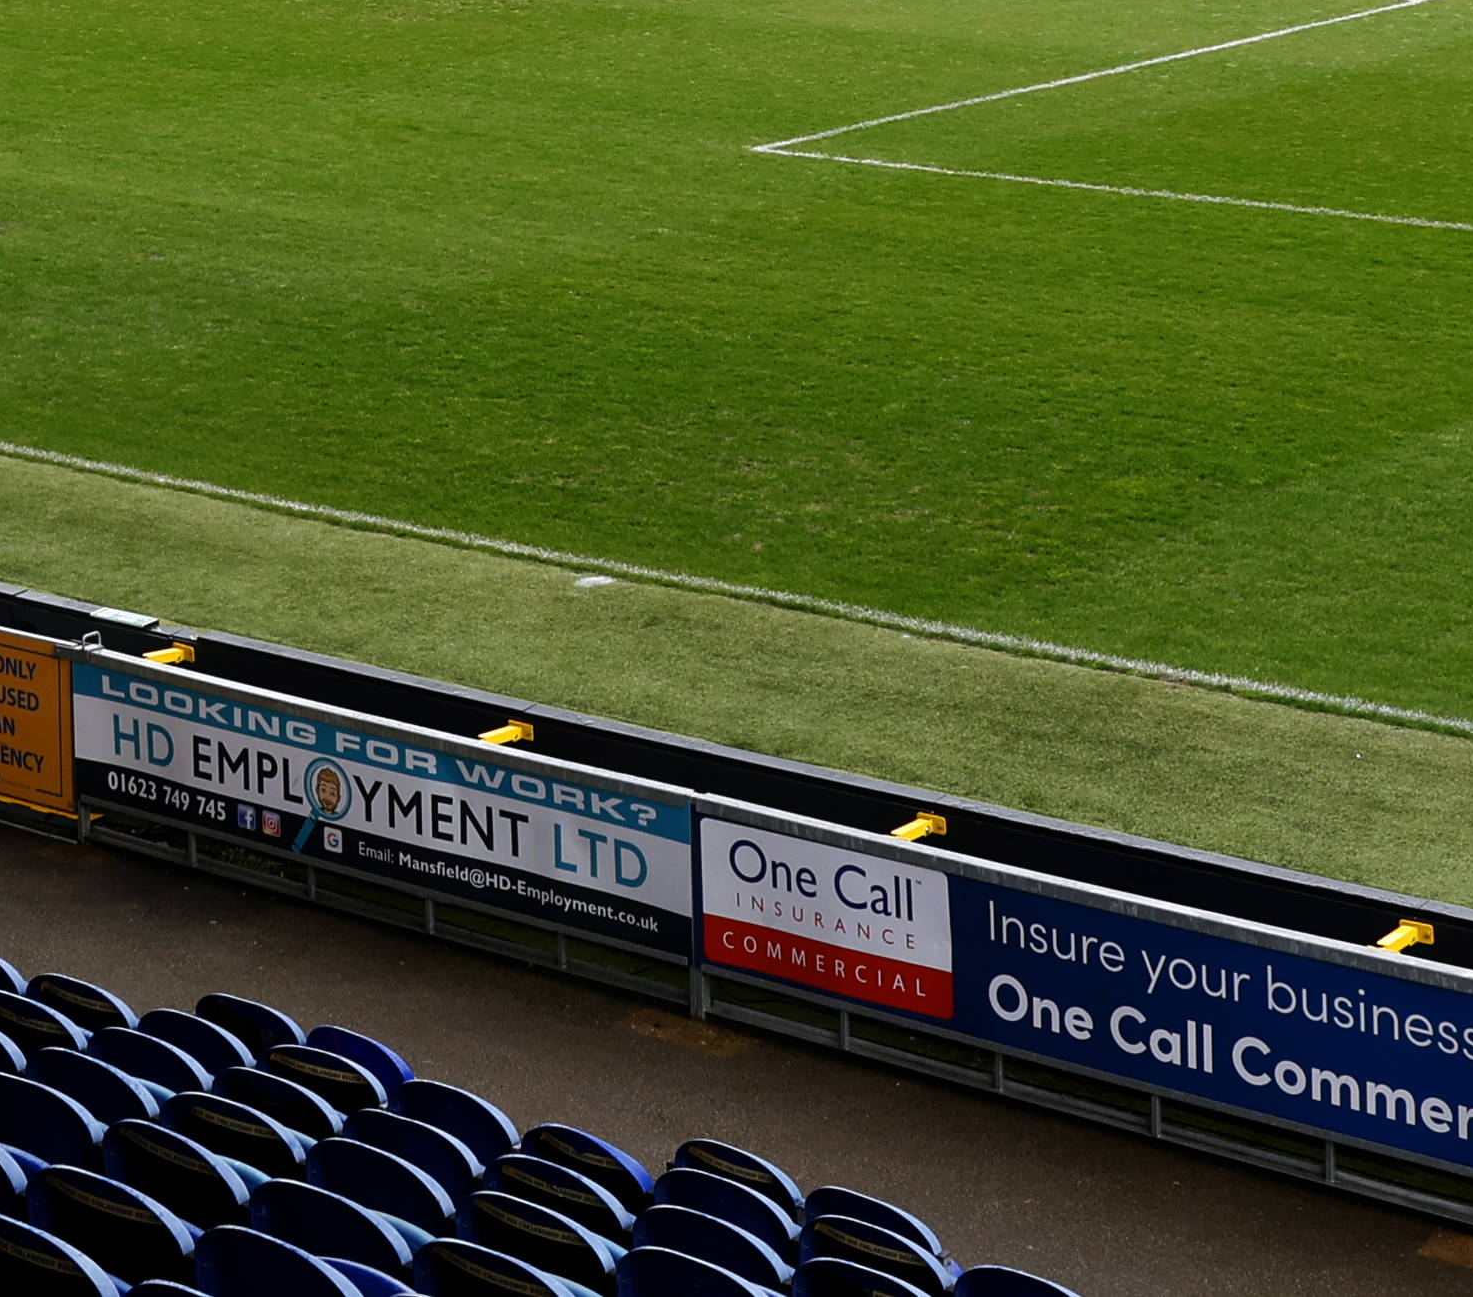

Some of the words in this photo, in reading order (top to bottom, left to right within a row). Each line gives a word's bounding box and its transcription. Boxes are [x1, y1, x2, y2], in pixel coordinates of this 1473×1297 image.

[102, 674, 317, 746] LOOKING
[336, 731, 438, 775] FOR
[455, 759, 656, 825] WORK?
[108, 771, 156, 801] 01623
[164, 785, 190, 811] 749
[197, 795, 226, 821] 745
[112, 714, 174, 767] HD
[554, 823, 648, 889] LTD
[358, 841, 394, 864] Email:
[399, 853, 658, 933] Mansfield@HD-Employment.co.uk
[729, 839, 817, 898] One
[833, 865, 915, 923] Call
[736, 891, 916, 951] INSURANCE
[722, 931, 926, 999] COMMERCIAL
[989, 900, 1125, 973] Insure
[1142, 949, 1250, 1001] your
[988, 975, 1093, 1041] One
[1110, 1005, 1214, 1075] Call
